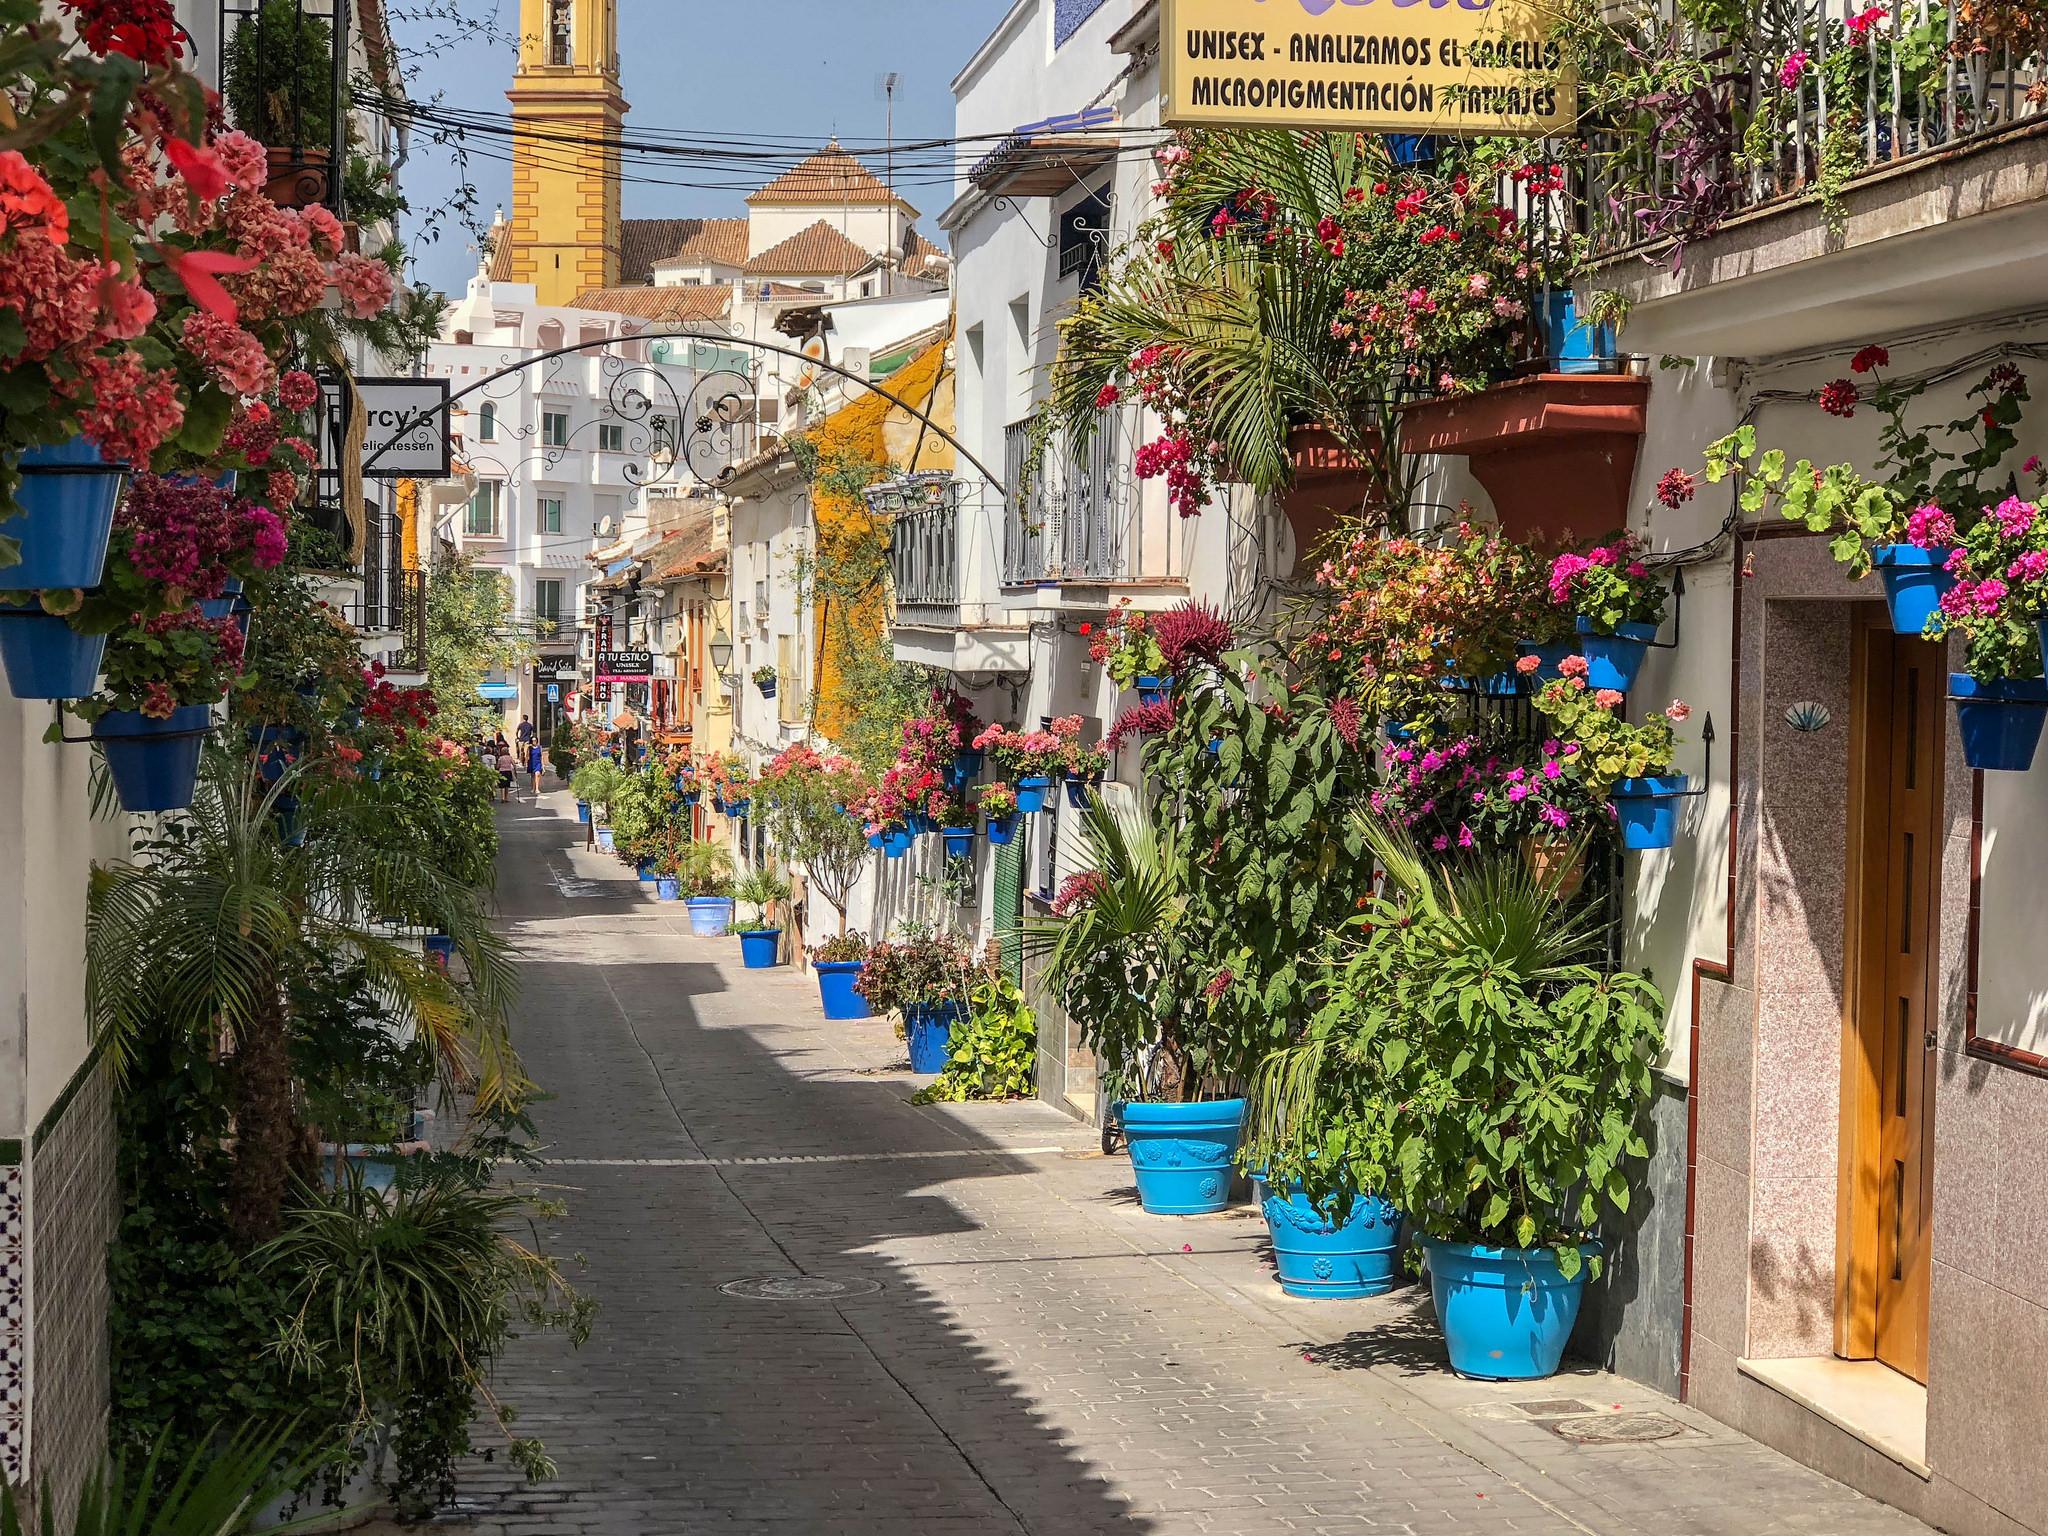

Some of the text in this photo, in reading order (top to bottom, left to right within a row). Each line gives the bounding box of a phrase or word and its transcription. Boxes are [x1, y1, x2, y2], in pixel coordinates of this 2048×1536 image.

[1187, 30, 1265, 61] UNISEX
[1290, 33, 1431, 66] ANALIZAMOS
[1439, 38, 1462, 67] EL
[1192, 75, 1433, 112] MICROPIGMENTACIÓN
[367, 405, 434, 433] rcy's
[362, 440, 434, 451] elictessen
[598, 652, 650, 662] A TU ESTILO
